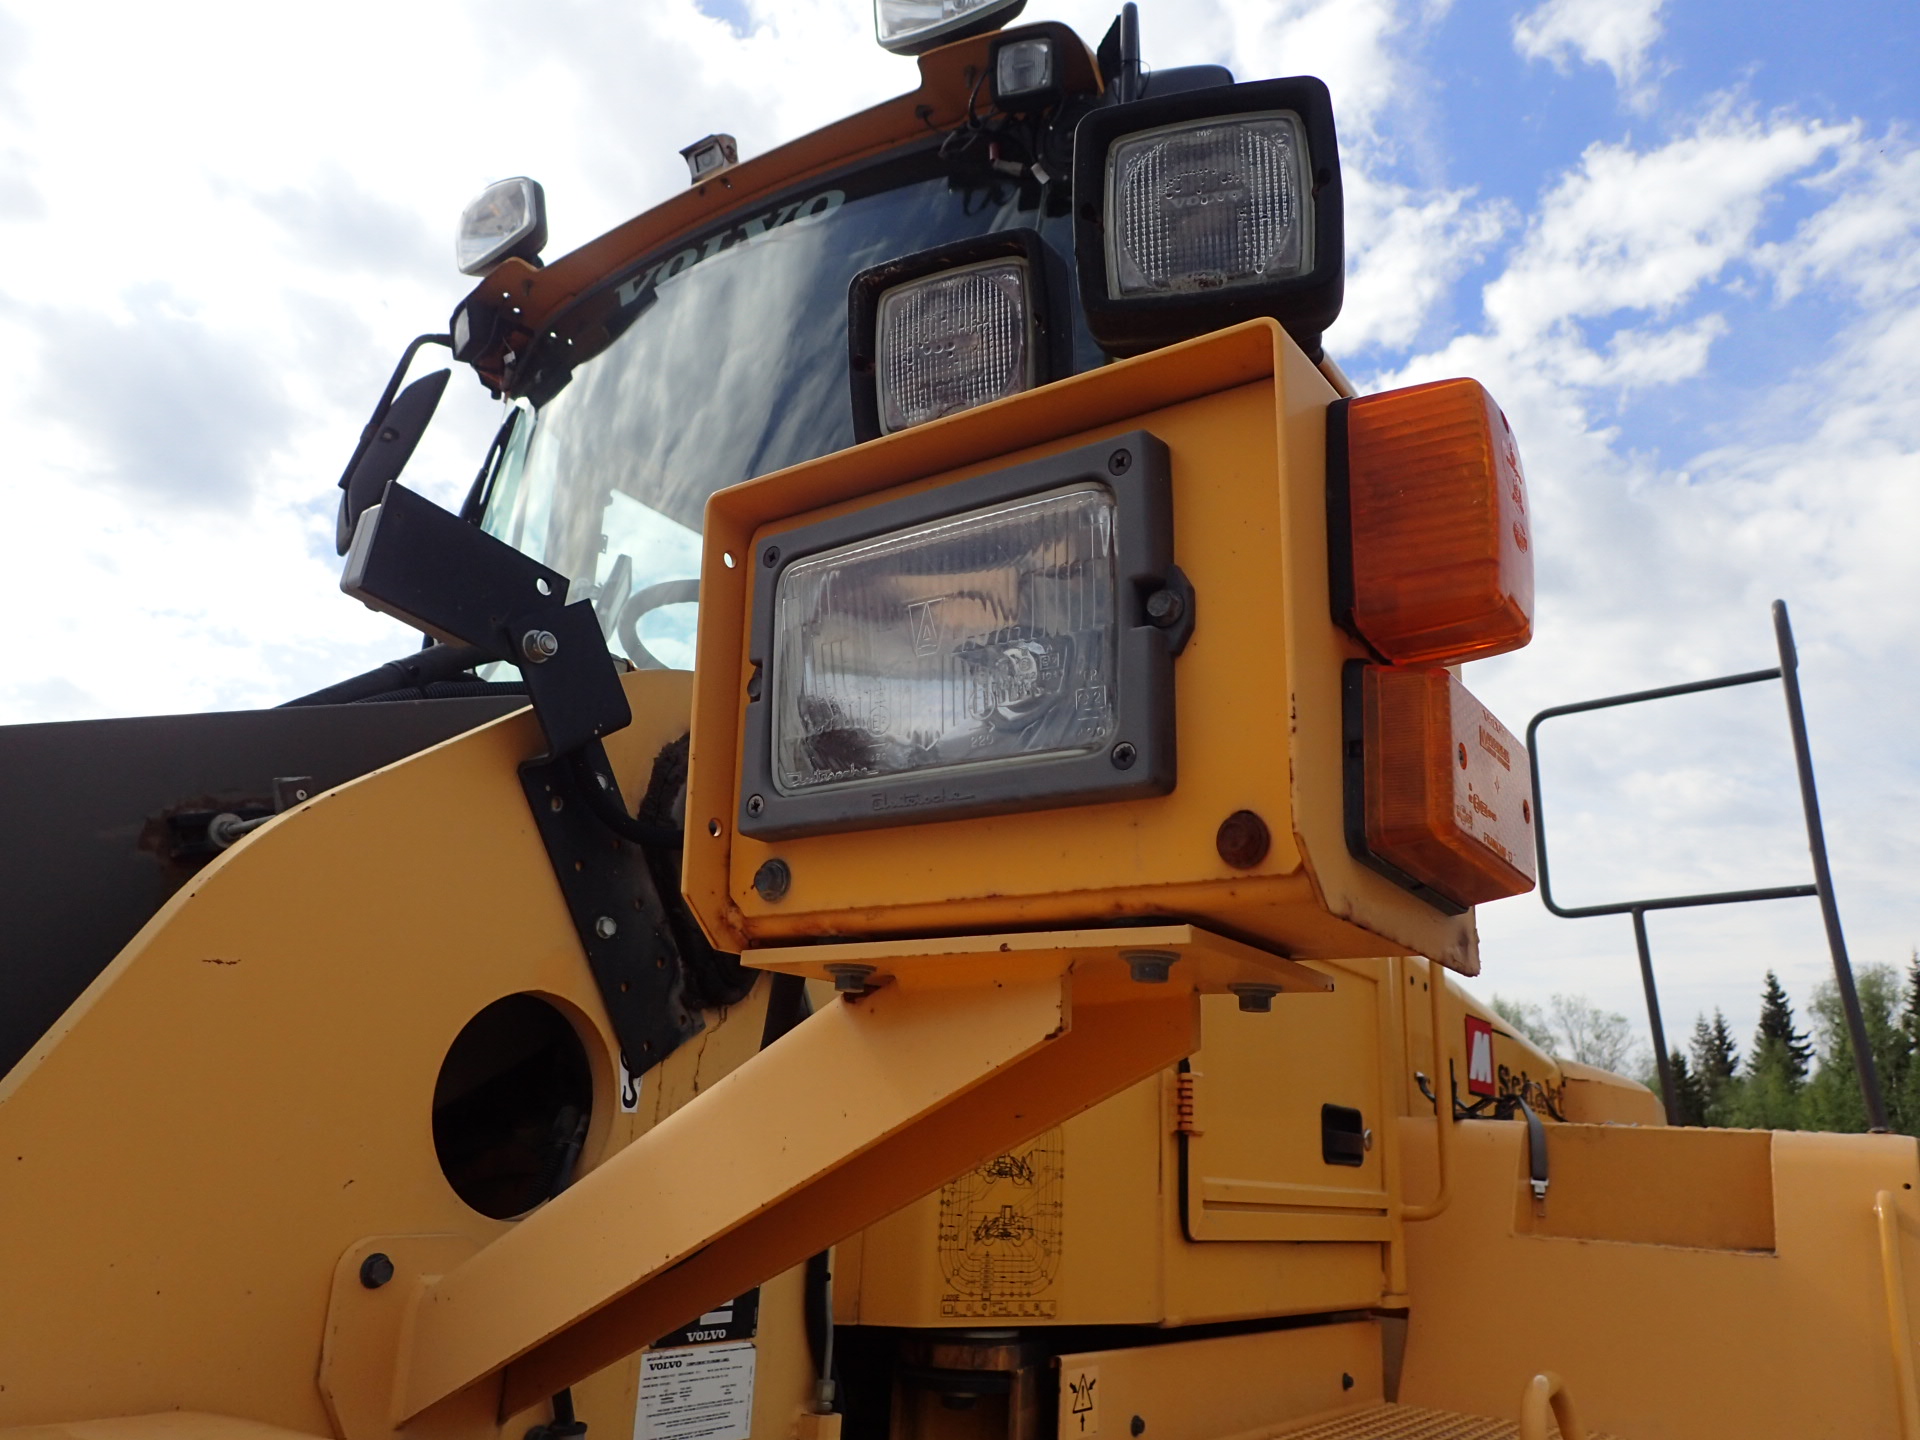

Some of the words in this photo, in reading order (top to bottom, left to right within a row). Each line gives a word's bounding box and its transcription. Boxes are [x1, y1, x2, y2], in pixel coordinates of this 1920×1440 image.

[614, 189, 846, 307] VOLVO
[686, 1329, 727, 1342] VOLVO
[649, 1360, 683, 1371] VOLVO
